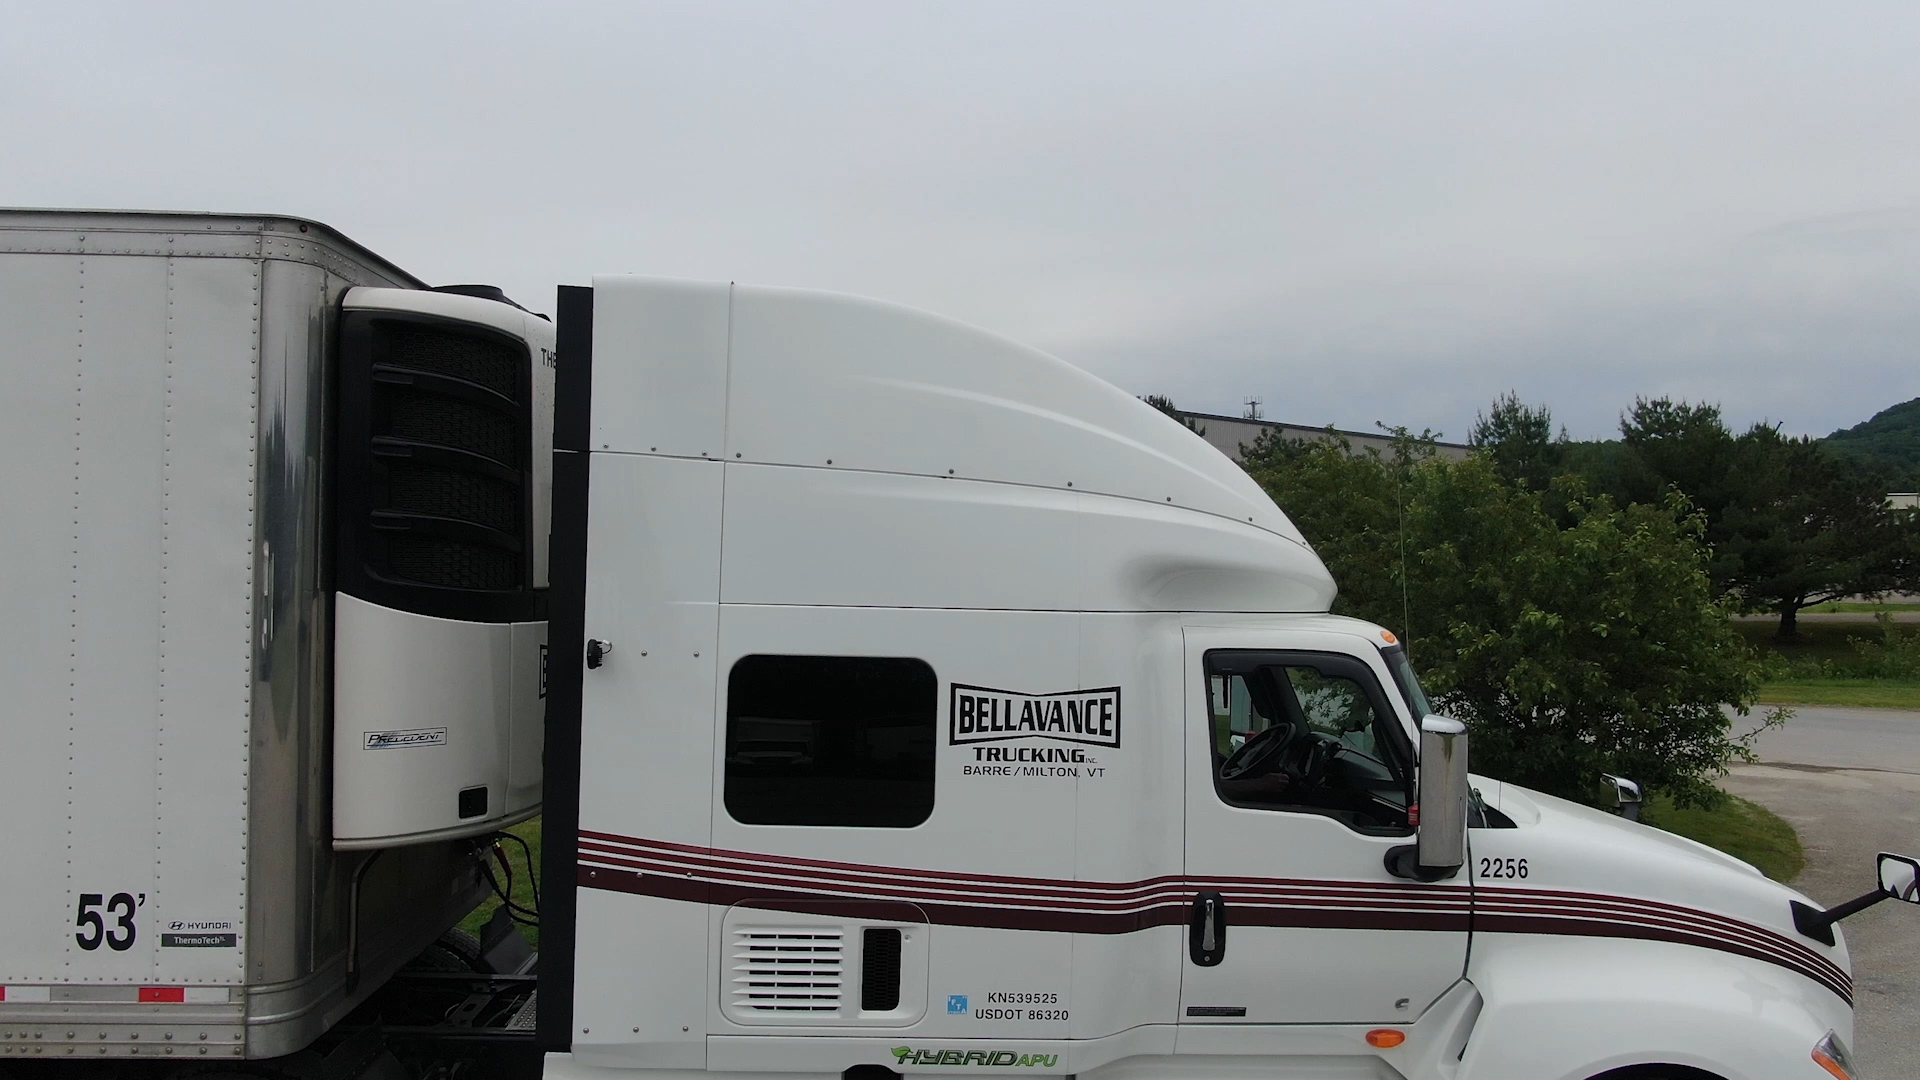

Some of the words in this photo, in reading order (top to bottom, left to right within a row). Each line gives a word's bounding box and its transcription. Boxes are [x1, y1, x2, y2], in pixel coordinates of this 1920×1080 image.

[959, 694, 1113, 737] BELLAVANCE
[973, 746, 1085, 763] TRUCKING
[1087, 767, 1106, 778] VT
[1480, 857, 1528, 879] 2256
[187, 921, 232, 930] HYUNDAI
[987, 992, 1059, 1004] KN539525
[975, 1009, 1024, 1020] USDOT
[1028, 1010, 1069, 1021] 86320
[897, 1049, 1018, 1066] HYBRID
[1015, 1054, 1059, 1067] APU
